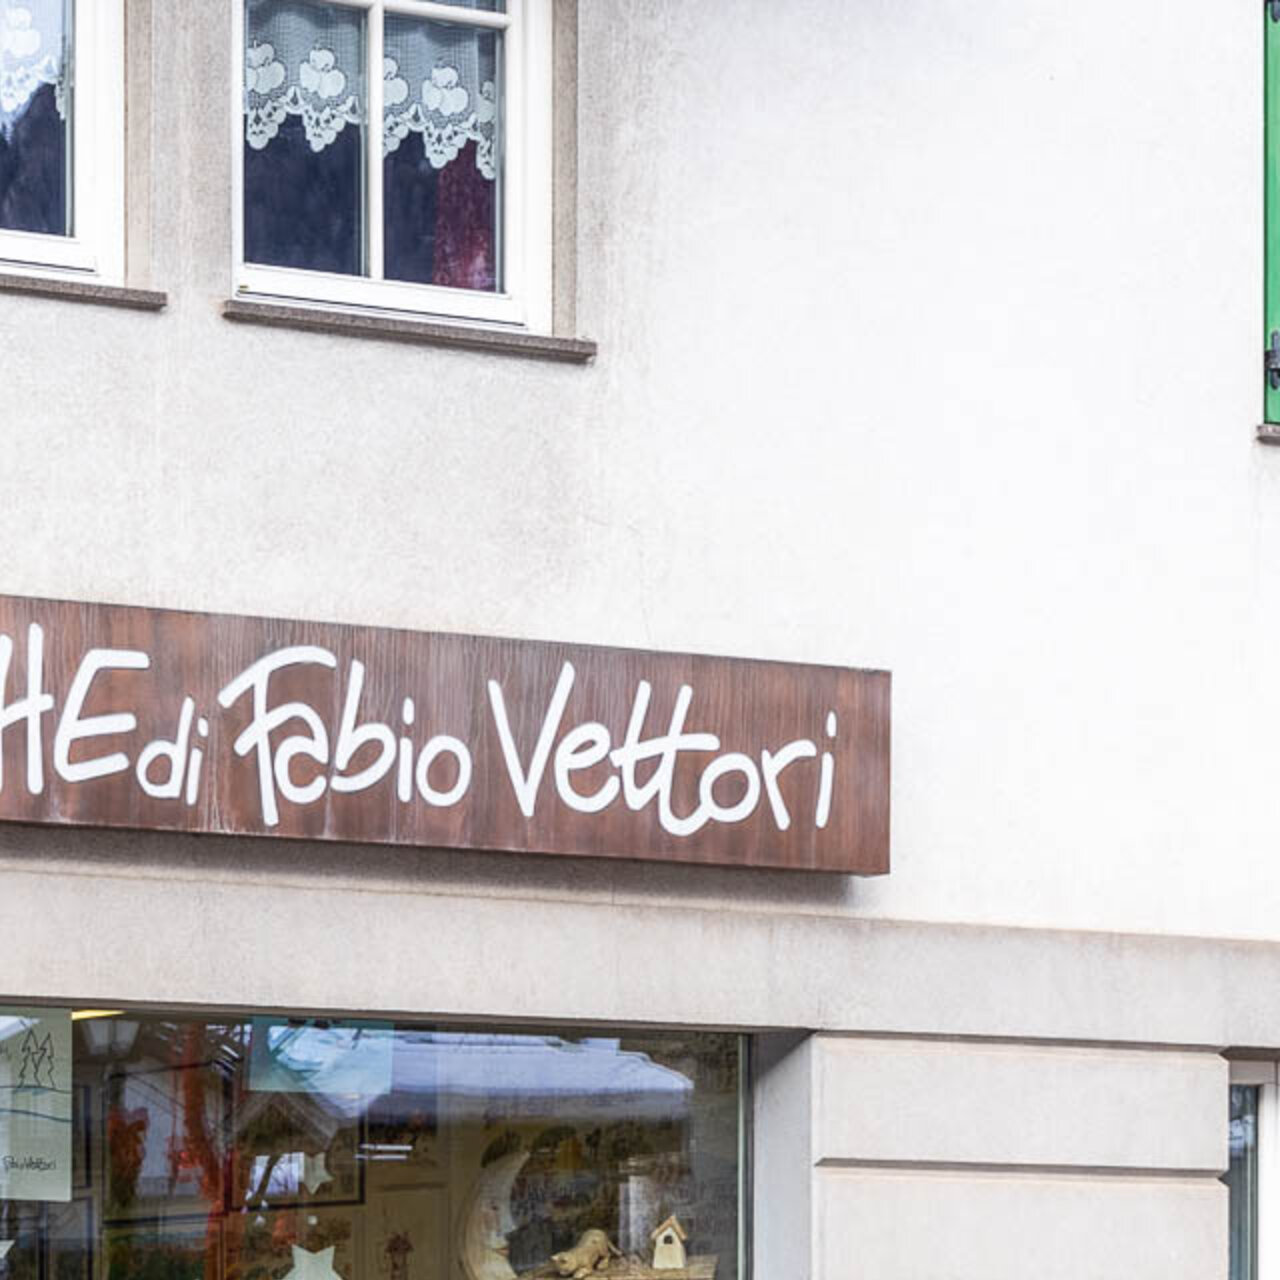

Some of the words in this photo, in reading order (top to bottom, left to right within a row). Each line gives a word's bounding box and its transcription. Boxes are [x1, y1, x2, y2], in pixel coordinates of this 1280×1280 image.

[136, 695, 207, 806] di
[217, 645, 472, 826] Fabio
[487, 661, 837, 836] Vettori
